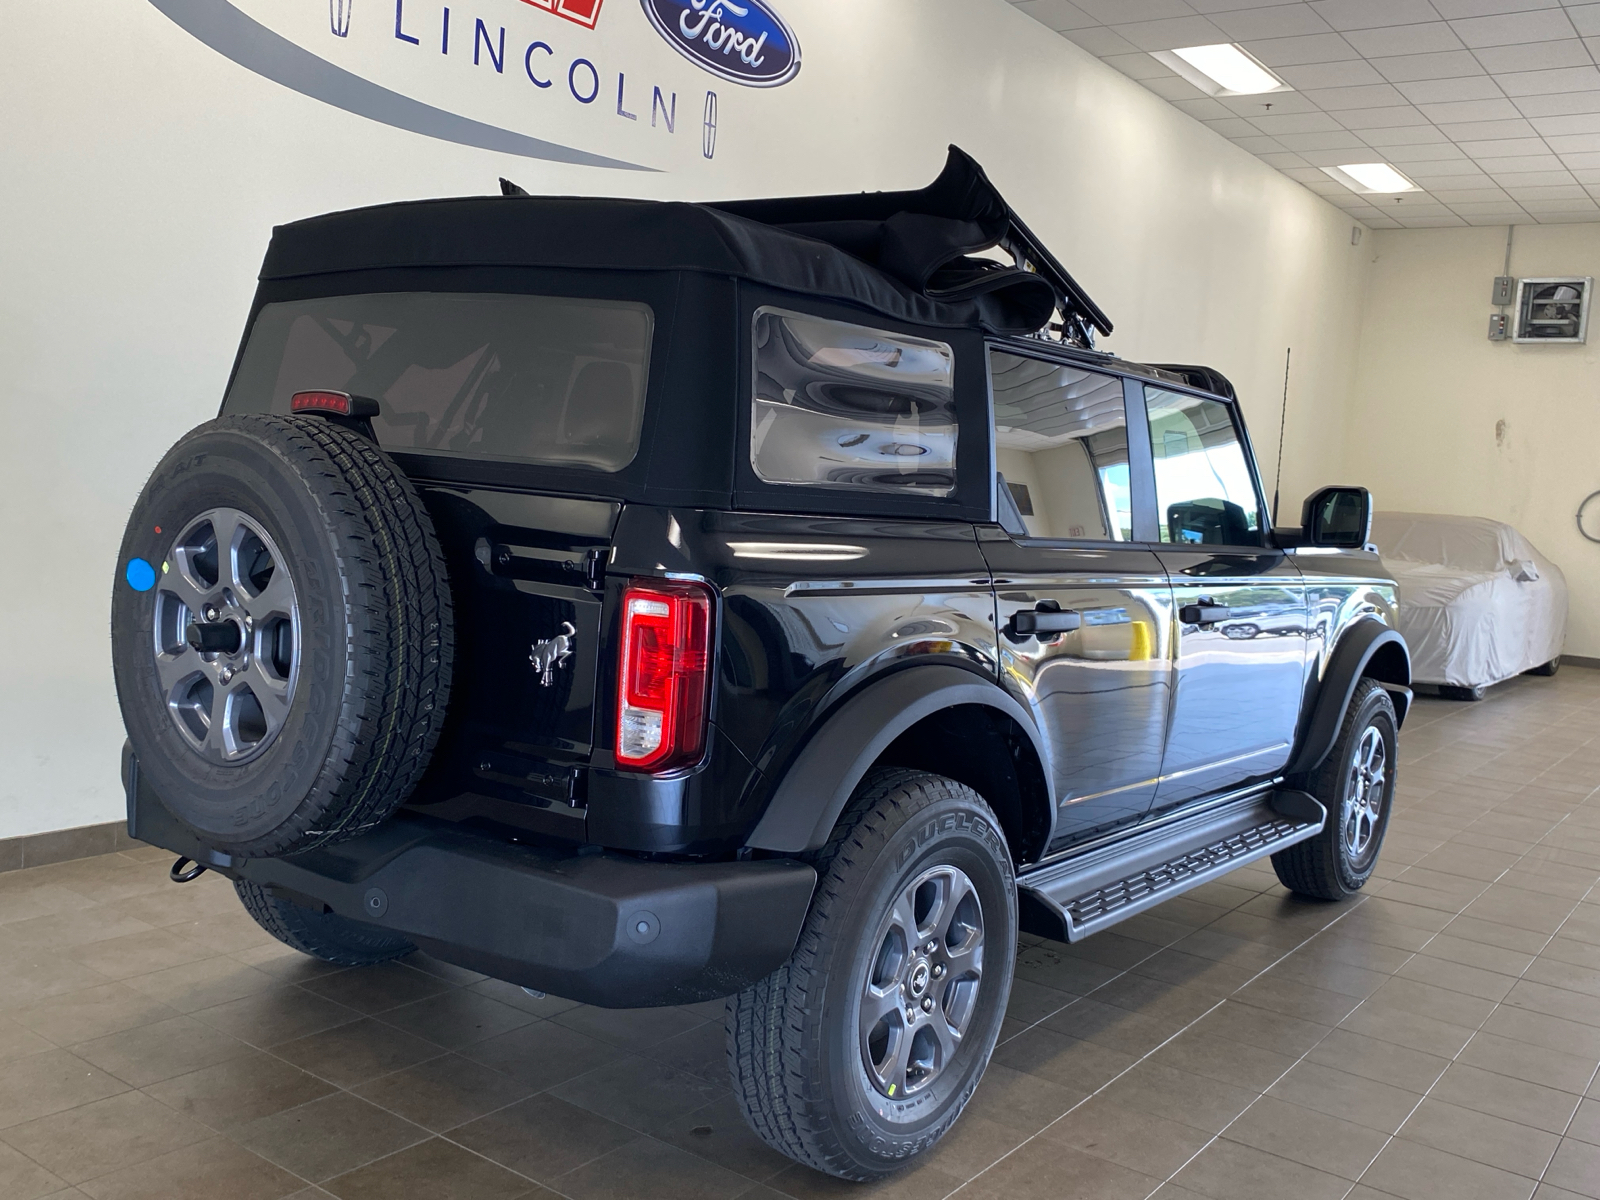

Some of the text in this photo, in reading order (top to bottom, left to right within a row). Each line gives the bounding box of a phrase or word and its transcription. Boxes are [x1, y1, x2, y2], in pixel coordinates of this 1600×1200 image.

[394, 0, 676, 134] LINCOLN
[679, 0, 768, 68] Ford
[896, 812, 1001, 874] DUELER
